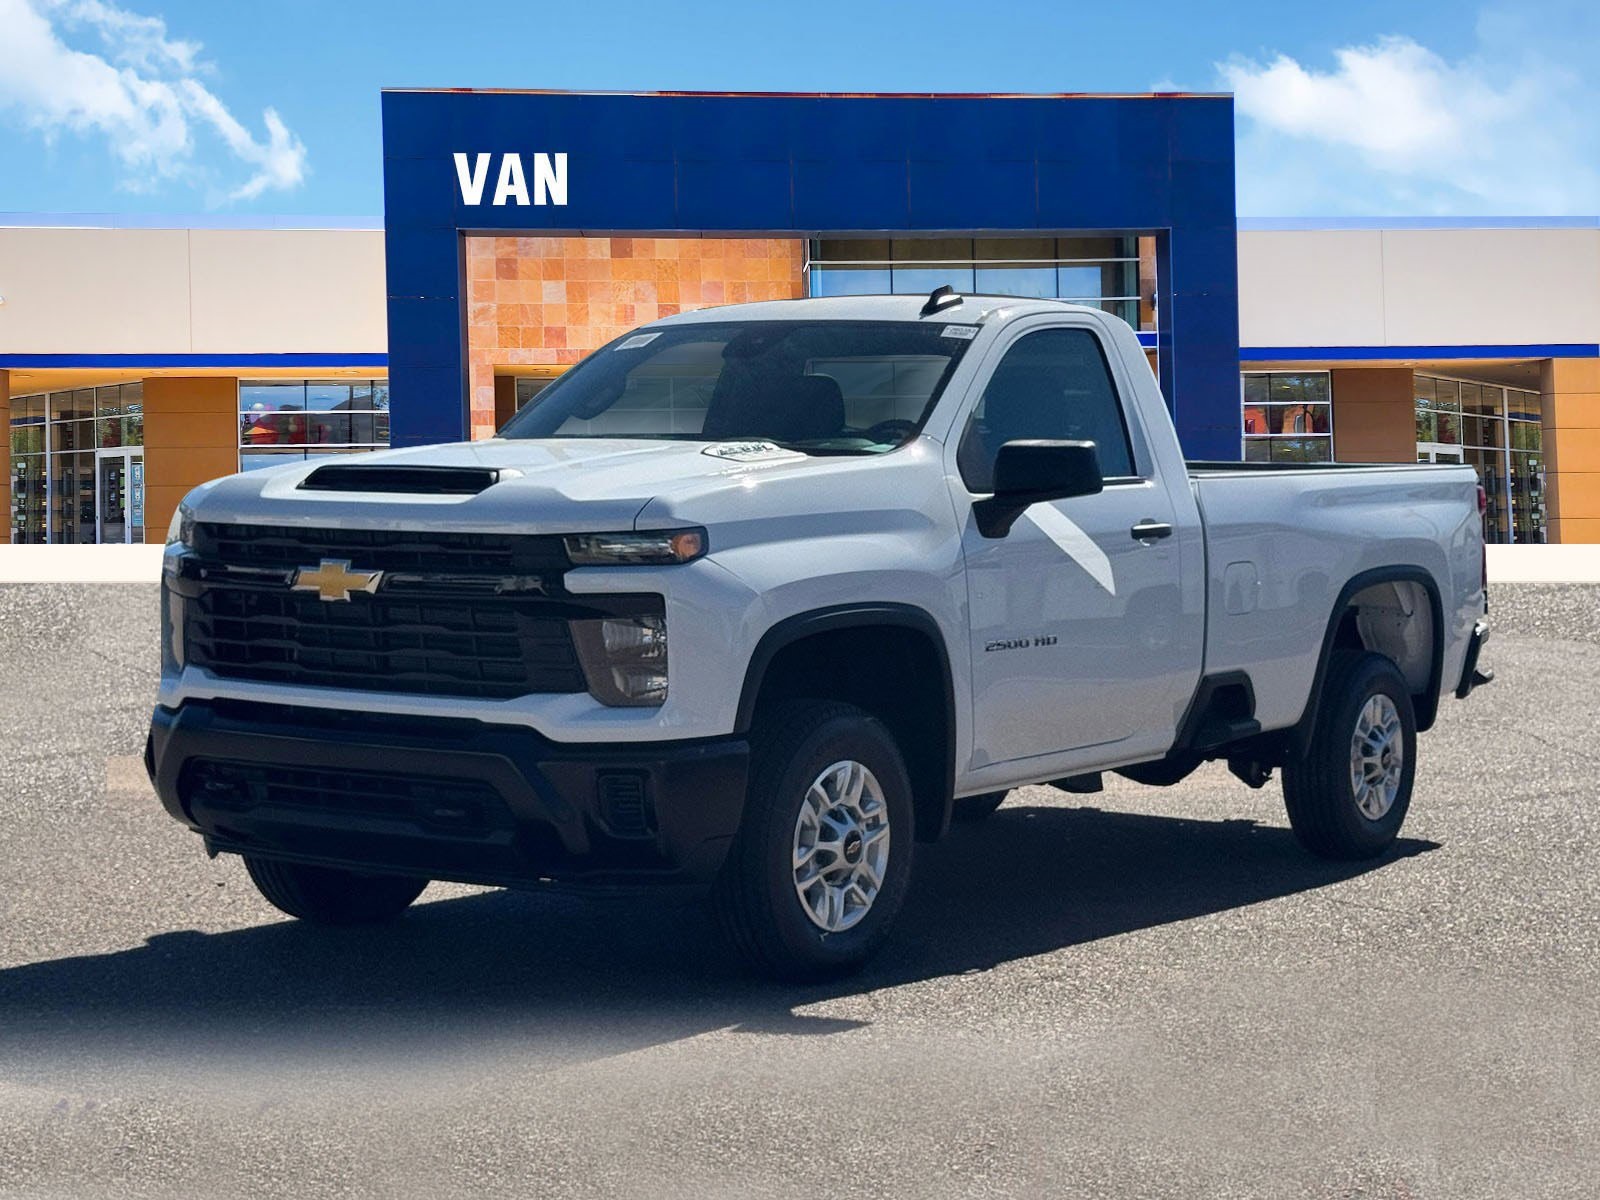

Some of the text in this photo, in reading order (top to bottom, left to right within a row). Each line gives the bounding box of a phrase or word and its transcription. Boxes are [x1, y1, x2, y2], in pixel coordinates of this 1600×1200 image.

[453, 152, 568, 206] VAN
[984, 635, 1058, 653] 2500 HD
